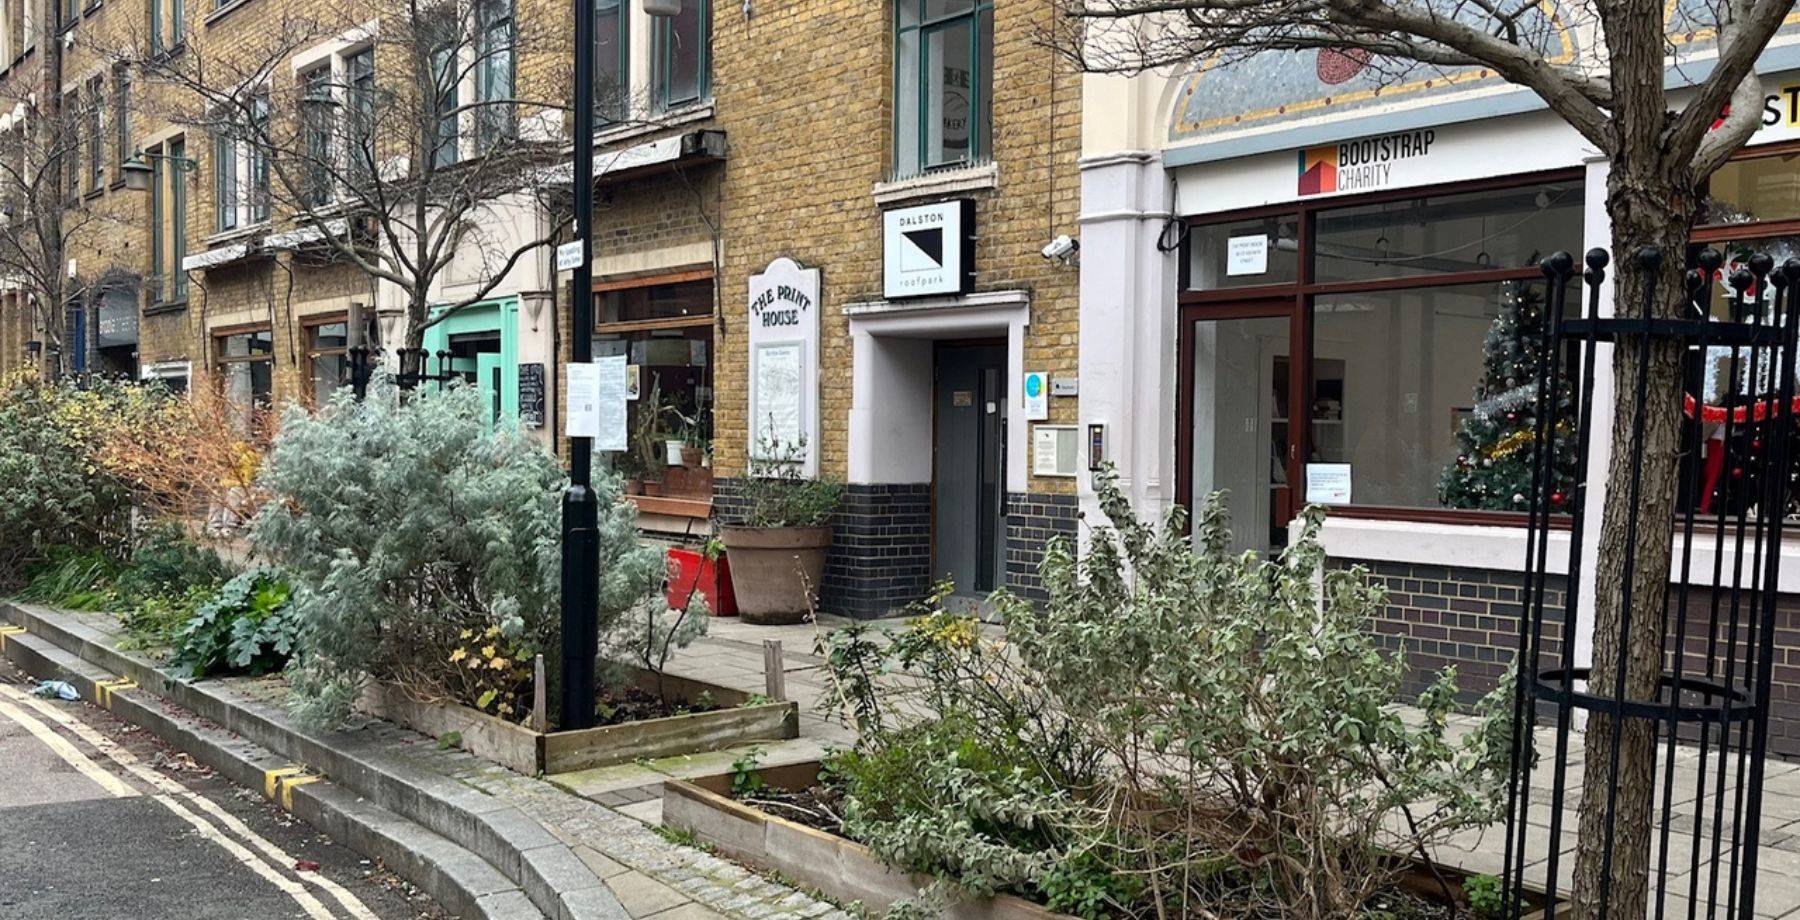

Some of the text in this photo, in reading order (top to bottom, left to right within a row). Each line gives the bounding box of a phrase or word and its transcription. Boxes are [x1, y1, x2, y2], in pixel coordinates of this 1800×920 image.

[1339, 129, 1435, 168] BOOTSTRAP
[1338, 163, 1392, 191] CHARITY
[899, 212, 944, 227] DALSTON
[899, 275, 944, 289] roofpark
[751, 285, 811, 315] THE PRINT
[762, 308, 799, 328] HOUSE
